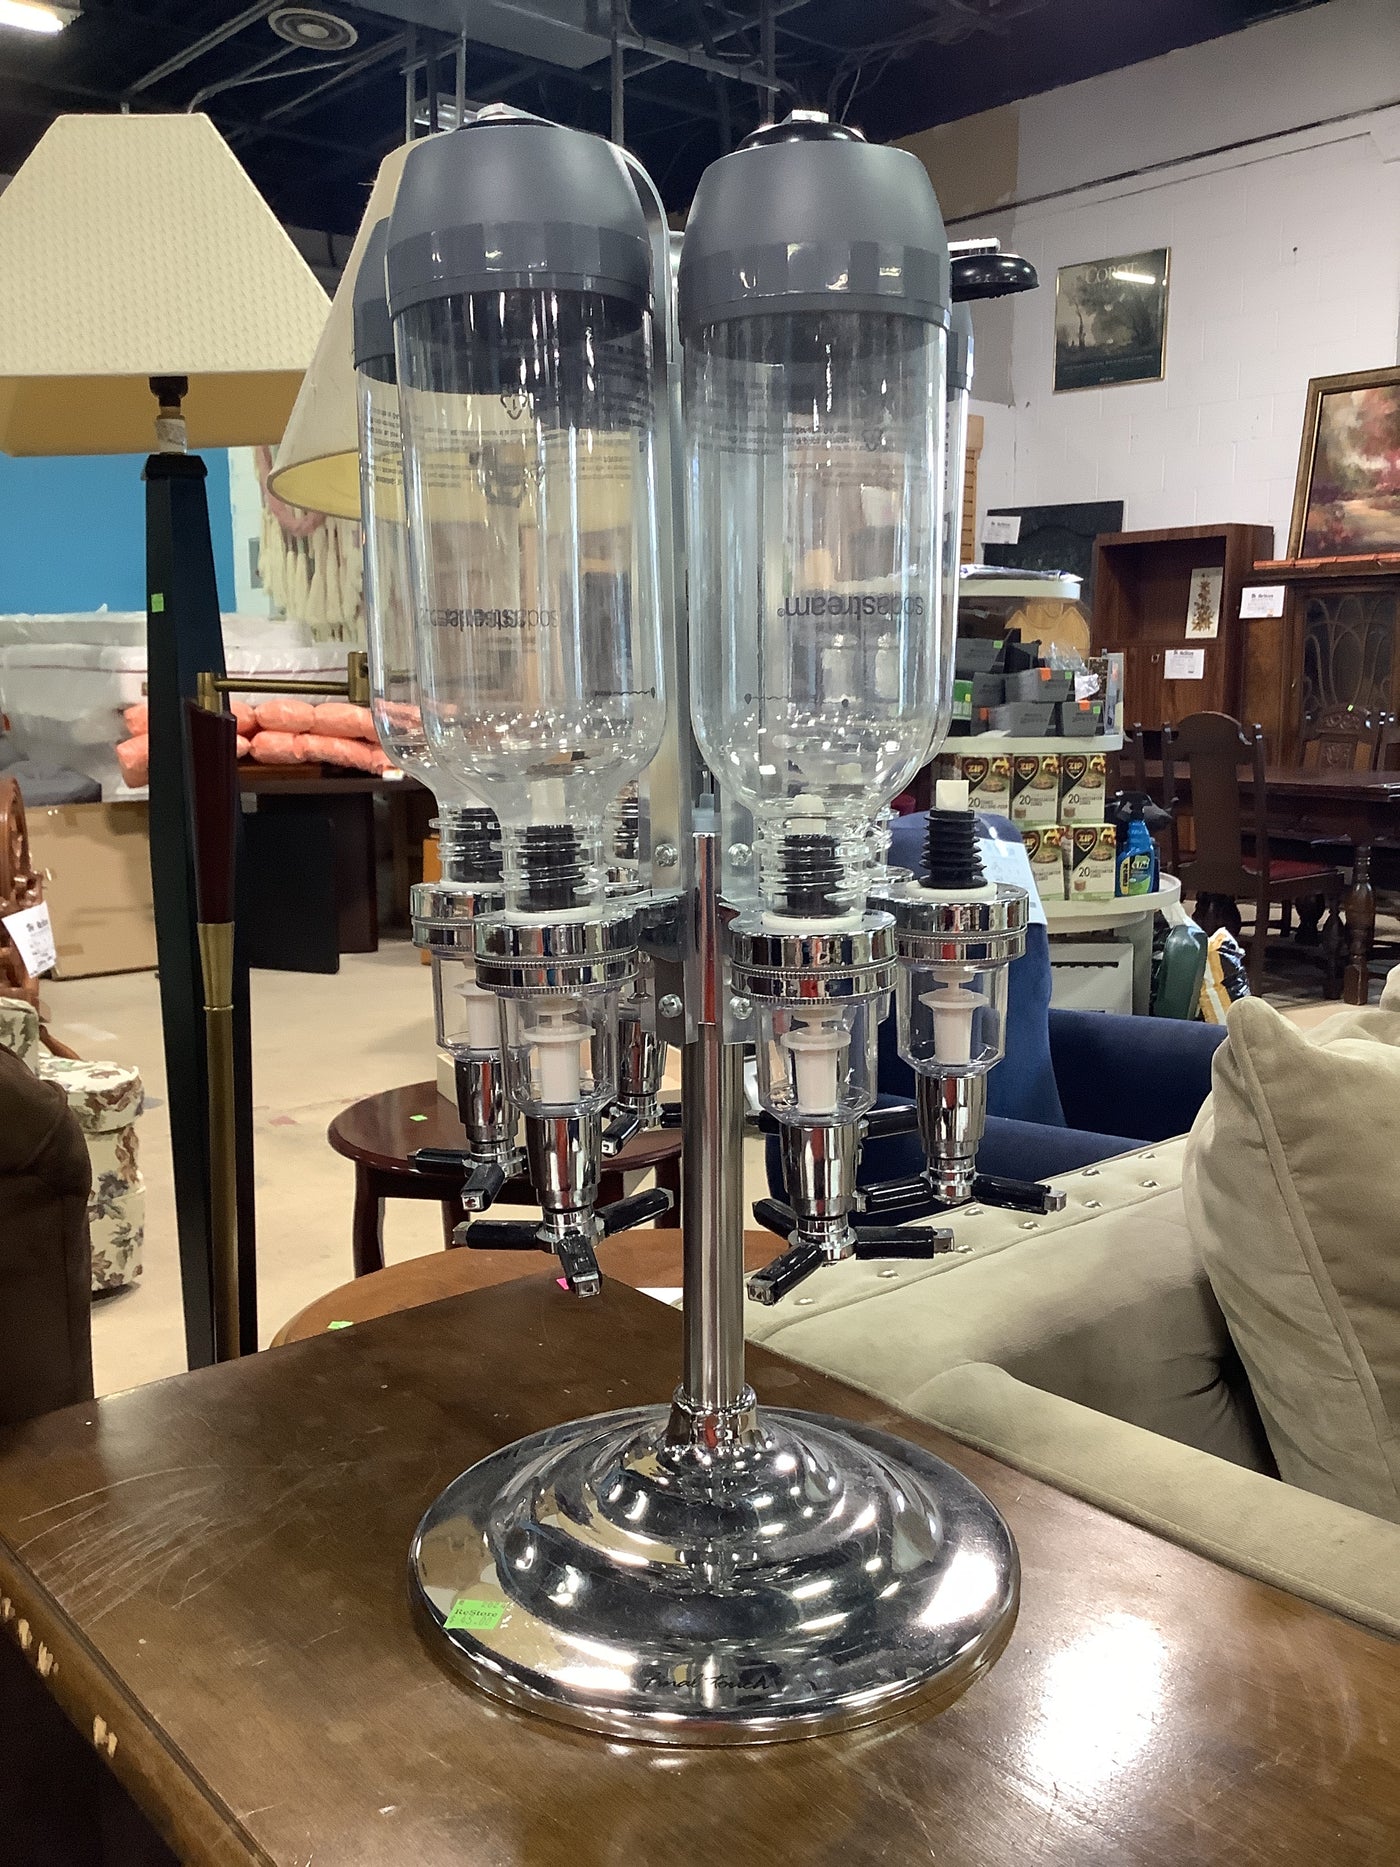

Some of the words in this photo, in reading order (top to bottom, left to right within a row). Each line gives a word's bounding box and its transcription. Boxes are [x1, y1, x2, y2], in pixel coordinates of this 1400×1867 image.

[968, 765, 983, 773] ZIP
[1020, 763, 1035, 771] ZIP
[1068, 762, 1083, 770] ZIP
[968, 797, 981, 808] 20
[1019, 795, 1031, 805] 20
[1068, 794, 1080, 804] 20
[1079, 834, 1094, 842] ZIP
[1079, 867, 1090, 877] 20
[454, 1609, 498, 1617] ReStore
